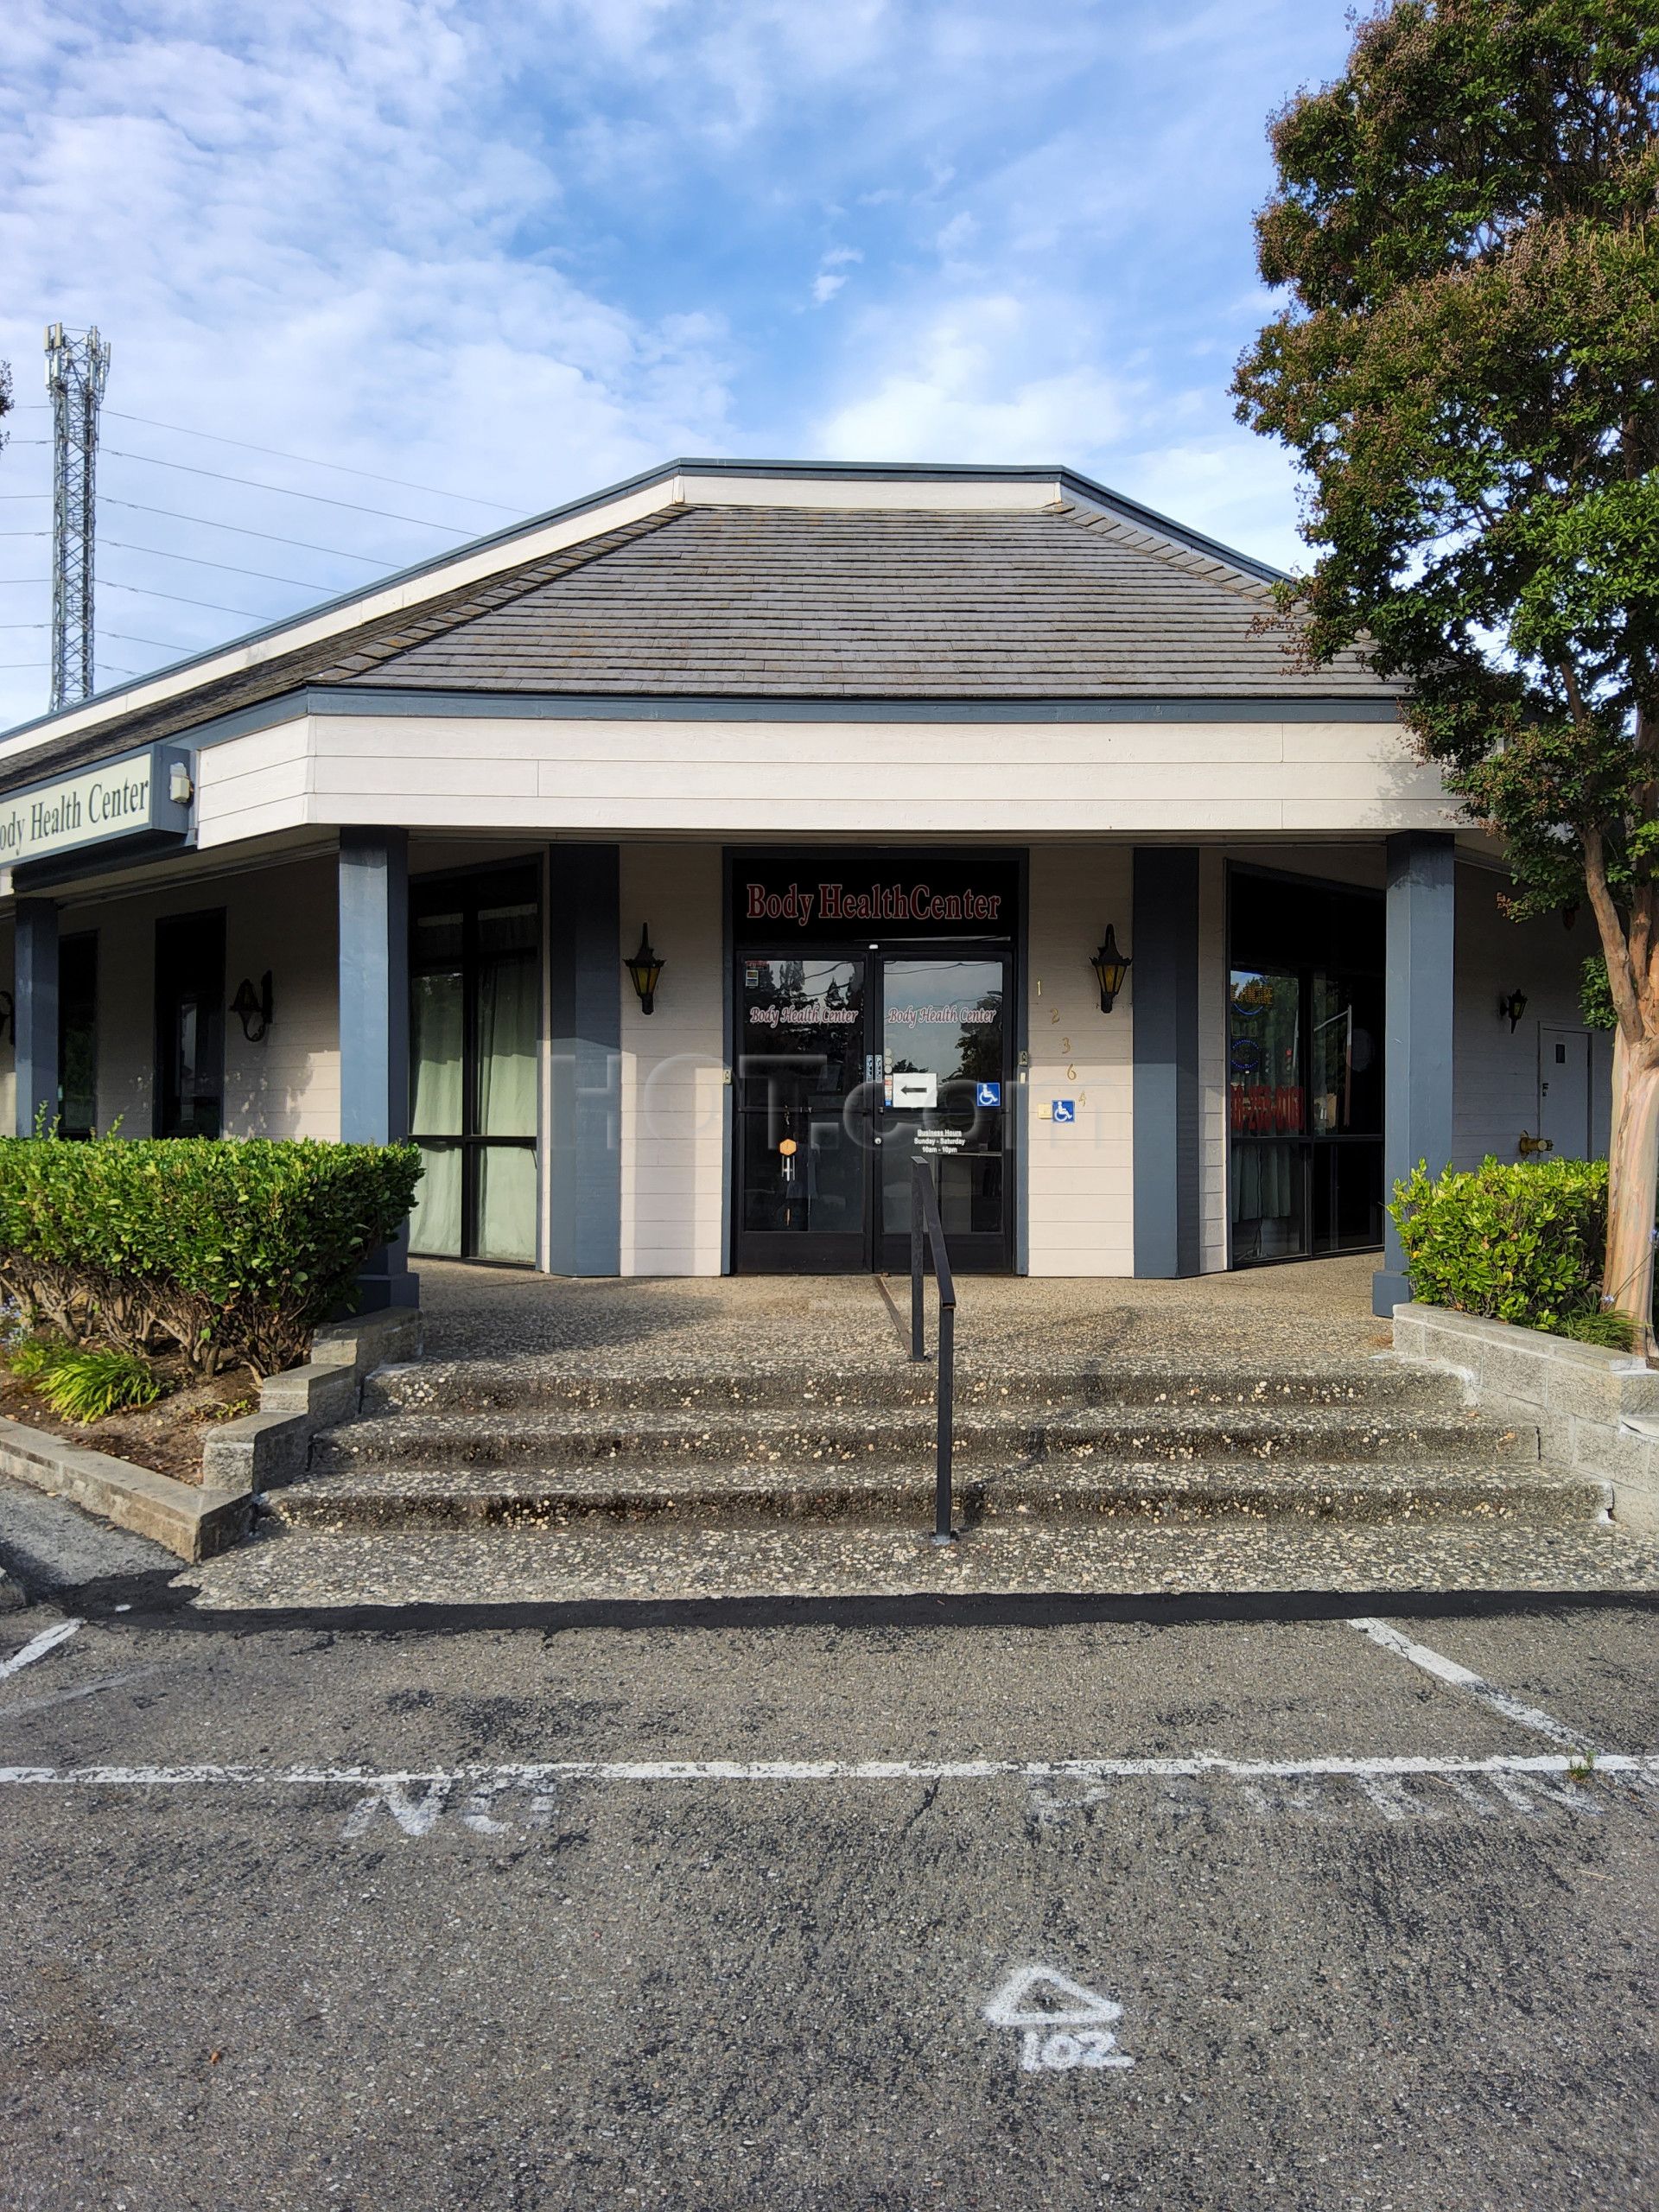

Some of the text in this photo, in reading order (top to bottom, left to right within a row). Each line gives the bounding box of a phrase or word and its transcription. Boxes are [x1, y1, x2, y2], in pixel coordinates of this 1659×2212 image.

[30, 791, 82, 842] Health
[88, 776, 149, 823] Center
[746, 883, 814, 926] Body
[749, 1004, 859, 1028] Body Health Center
[888, 1004, 996, 1028] Body Health Center
[914, 1137, 936, 1146] Sunday
[940, 1137, 965, 1146] Saturday
[917, 1128, 962, 1137] Business Hours
[1020, 2031, 1135, 2071] 102
